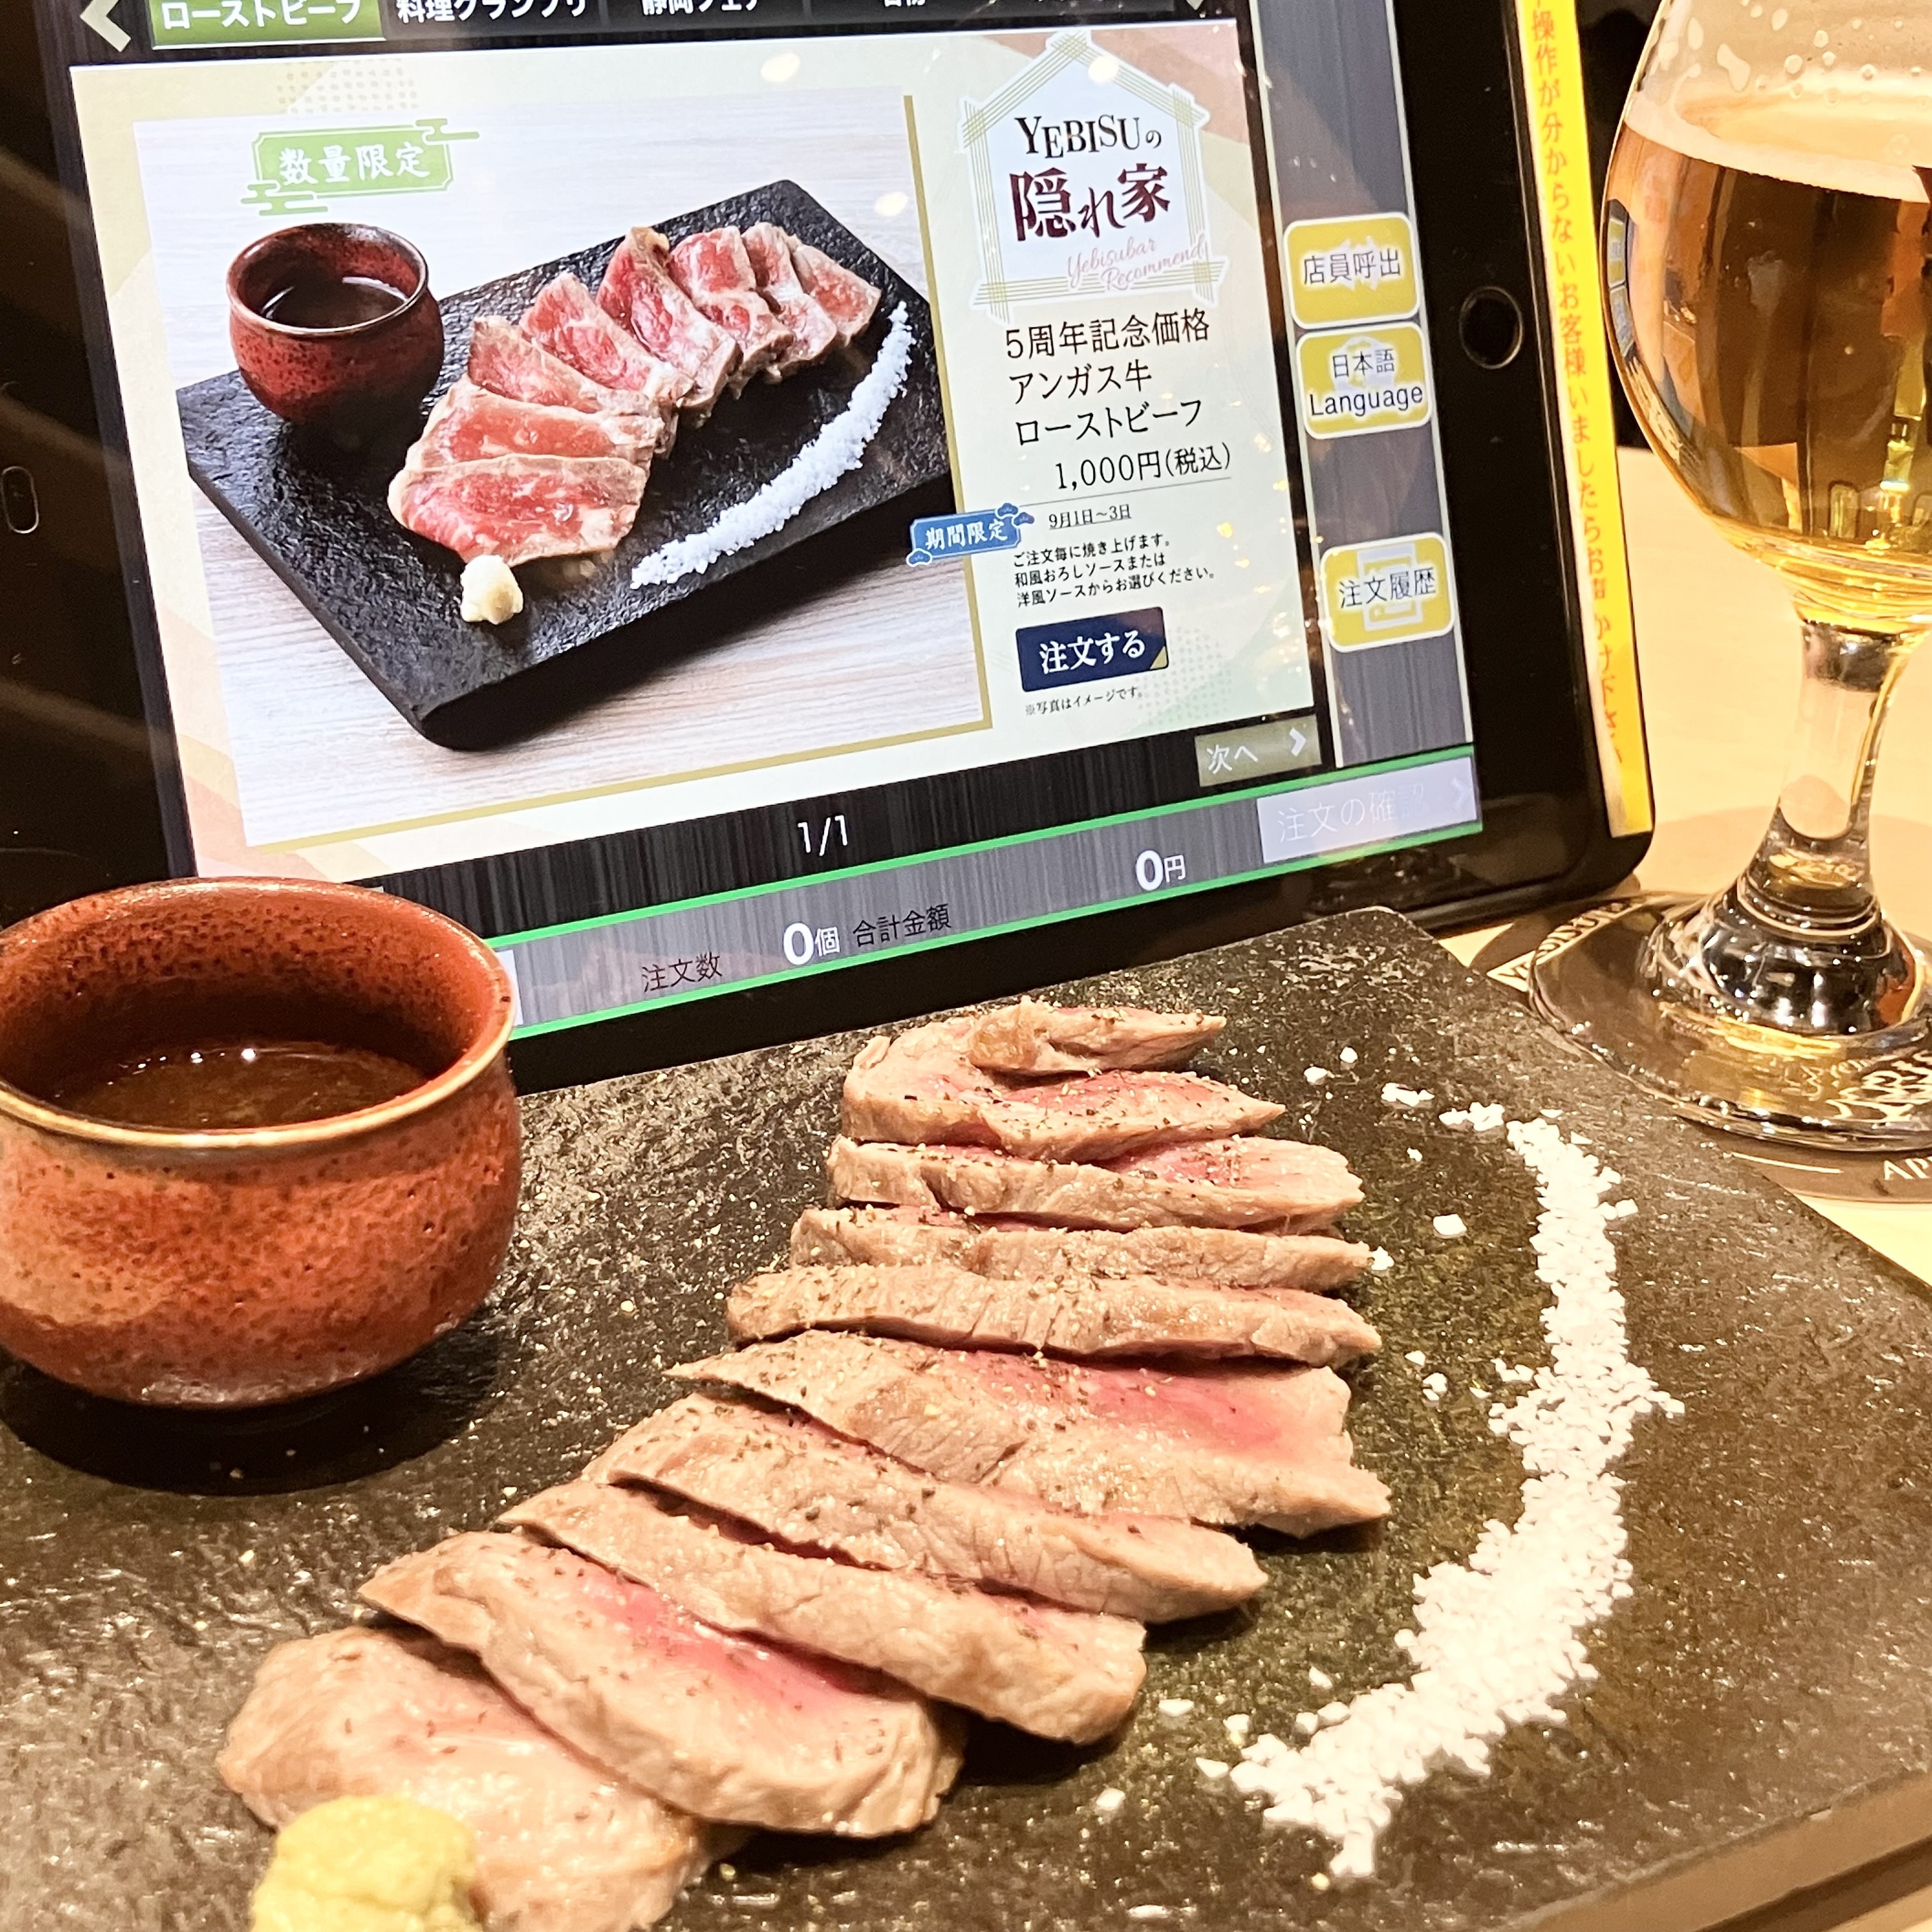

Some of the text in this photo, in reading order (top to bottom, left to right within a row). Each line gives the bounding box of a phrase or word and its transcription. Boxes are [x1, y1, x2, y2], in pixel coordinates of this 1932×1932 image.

[162, 0, 360, 29] ローストビーフ
[1015, 114, 1162, 158] YEBISUの
[279, 142, 430, 185] 数量限定
[1009, 163, 1170, 241] 隠れ家
[1068, 236, 1157, 288] Yebisubar
[1100, 233, 1206, 291] Recommend
[1303, 248, 1401, 286] 店員呼出
[1006, 307, 1209, 359] 5周年記念価格
[1009, 359, 1152, 404] アンガス牛
[1331, 349, 1395, 379] 日本語
[1016, 401, 1201, 445] ローストビーフ
[1310, 385, 1423, 418] Language
[924, 519, 1008, 550] 期間限定
[1014, 533, 1170, 567] ご注文毎に焼き上げます。
[1015, 552, 1165, 588] 和風おろしソースまたは
[1017, 567, 1215, 608] 洋風ソースからお選びください。
[1338, 566, 1437, 609] 注文履歴
[1039, 630, 1146, 675] 注文する
[1206, 745, 1258, 774] 次へ
[798, 815, 848, 857] 1/1
[641, 951, 723, 993] 注文数
[852, 903, 952, 947] 合計金額
[1135, 850, 1186, 891] 0円
